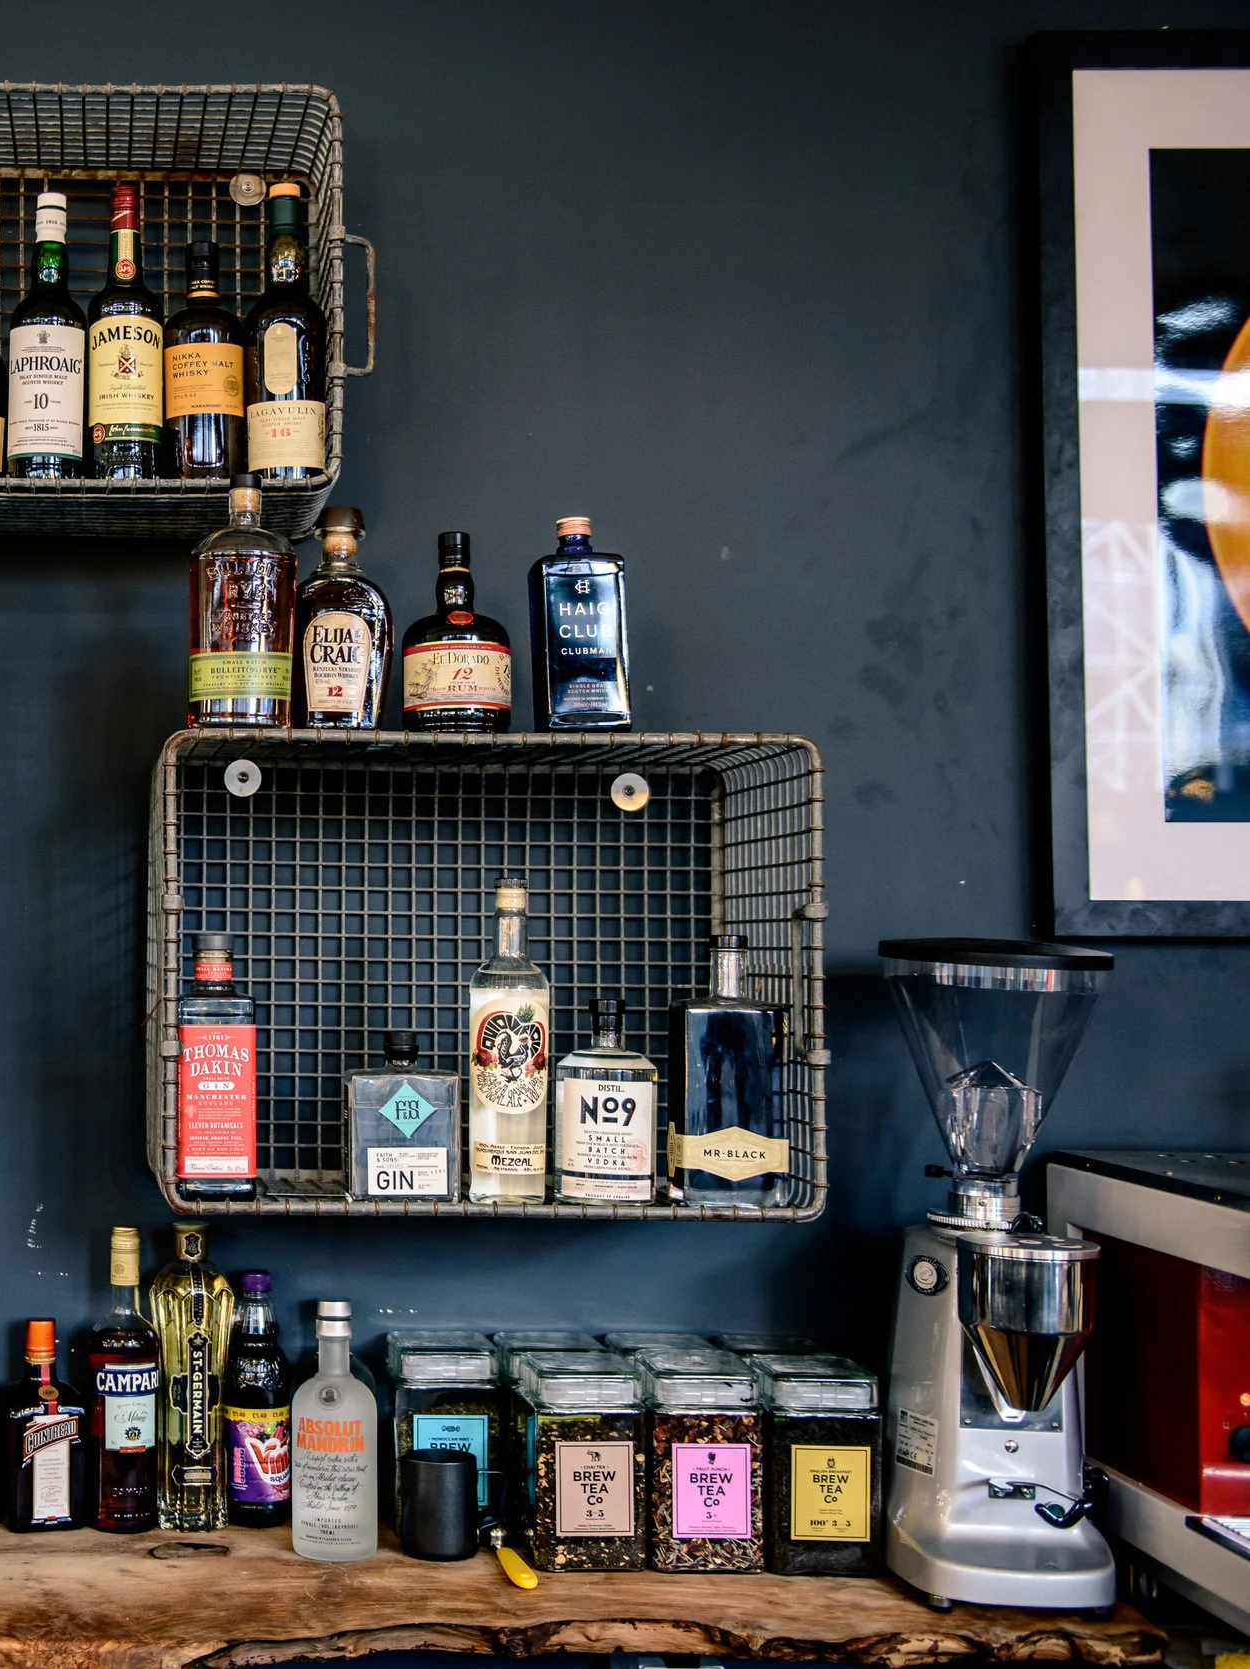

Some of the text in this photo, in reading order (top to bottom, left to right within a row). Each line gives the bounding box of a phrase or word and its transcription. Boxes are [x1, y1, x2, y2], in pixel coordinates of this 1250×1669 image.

[92, 325, 161, 351] JAMESON
[172, 352, 201, 361] NIKKA
[10, 355, 82, 375] LAPHROAIG
[172, 360, 235, 371] COFFEY MALT
[172, 369, 209, 379] WHISKY
[33, 392, 49, 410] 10
[121, 392, 155, 400] WHISKEY
[250, 406, 317, 419] LAGAVULIN
[33, 423, 50, 432] 1815
[270, 427, 292, 438] 16
[559, 601, 610, 617] HAIG
[559, 624, 614, 639] CLUB
[561, 647, 613, 656] CLUBMAN
[448, 651, 490, 666] DORADO
[210, 666, 246, 674] BULLEIT
[452, 667, 474, 681] 12
[326, 685, 343, 697] 12
[183, 1043, 250, 1063] THOMAS
[189, 1060, 243, 1078] DAKIN
[598, 1084, 625, 1093] DISTIL.
[588, 1134, 626, 1143] SMALL
[588, 1146, 626, 1155] BATCH
[727, 1149, 766, 1160] BLACK
[491, 1154, 534, 1167] MEZCAL
[376, 1170, 414, 1190] GIN
[298, 1416, 363, 1437] ABSOLUT
[24, 1419, 76, 1454] COINTREAU
[296, 1431, 365, 1453] MANDRIN
[573, 1470, 617, 1482] BREW
[689, 1472, 733, 1484] BREW
[812, 1474, 849, 1484] BREW
[580, 1482, 609, 1494] TEA
[697, 1485, 726, 1496] TEA
[819, 1484, 843, 1494] TEA
[586, 1494, 604, 1506] Co
[703, 1496, 720, 1508] Co
[823, 1494, 838, 1504] Co
